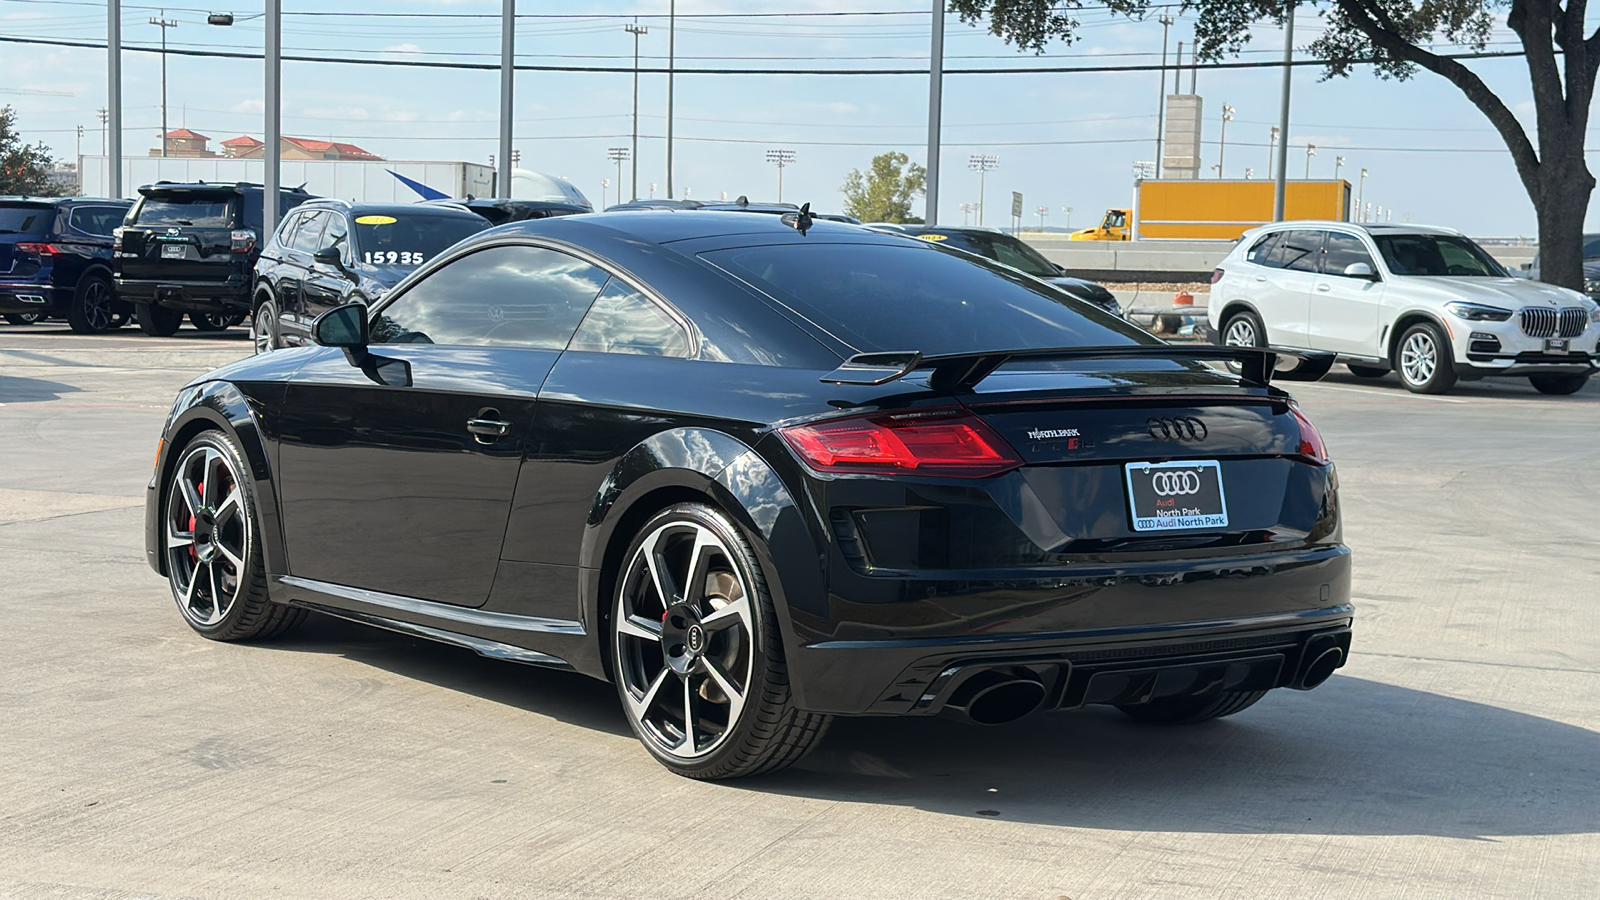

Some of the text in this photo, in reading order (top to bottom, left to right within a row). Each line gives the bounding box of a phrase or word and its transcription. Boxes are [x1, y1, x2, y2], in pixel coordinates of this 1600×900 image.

[365, 251, 424, 265] 15935
[1156, 498, 1175, 507] Audi
[1156, 507, 1201, 518] North Park
[1156, 516, 1225, 528] Audi North Park
